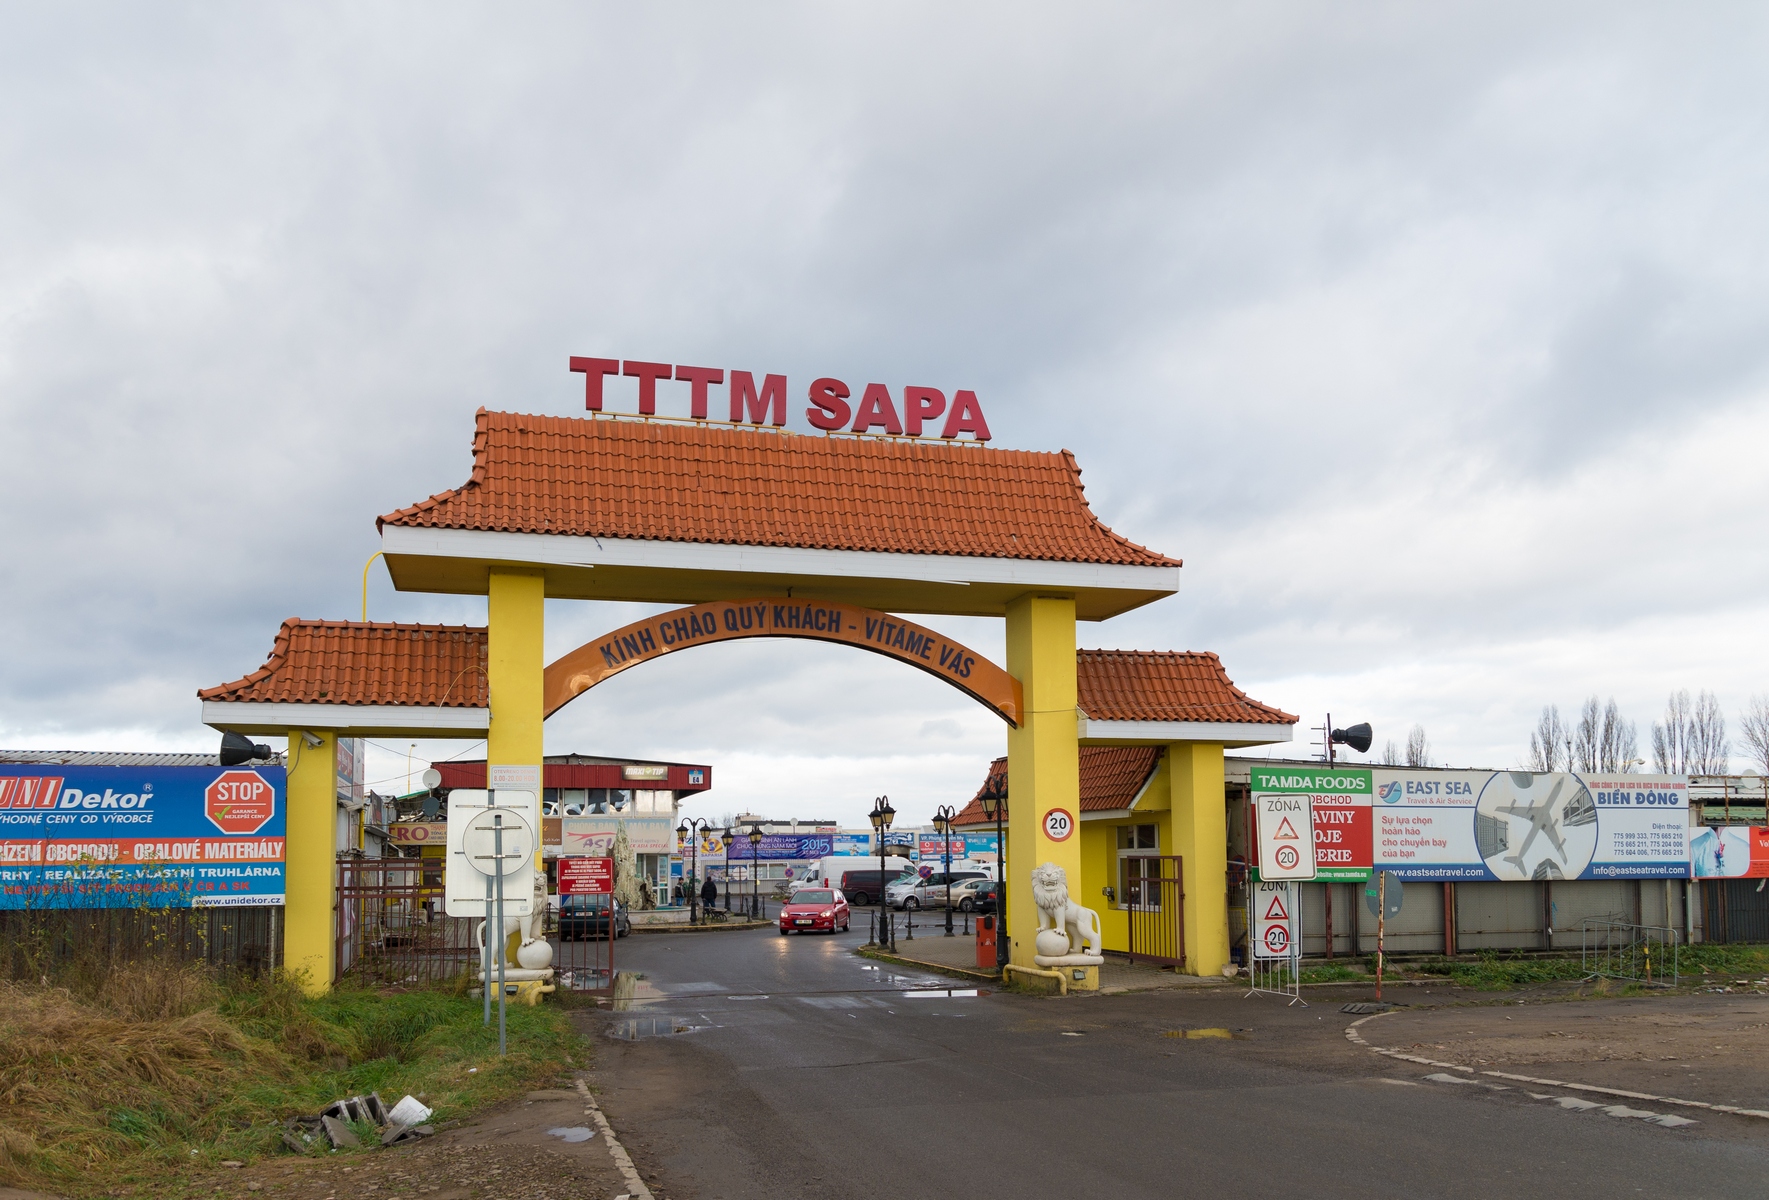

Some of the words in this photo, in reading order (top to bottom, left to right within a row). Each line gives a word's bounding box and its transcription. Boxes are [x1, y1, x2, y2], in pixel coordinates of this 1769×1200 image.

[569, 356, 787, 426] TTTM
[806, 378, 992, 441] SAPA
[600, 628, 656, 668] KÍNH
[660, 611, 717, 645] CHÀO
[723, 602, 767, 632] QUÝ
[774, 603, 841, 633] KHÁCH
[865, 617, 935, 660] VÍTÁME
[938, 643, 975, 678] VÁS
[625, 767, 645, 776] MAXI
[652, 768, 665, 776] TIP
[1258, 775, 1314, 789] TAMDA
[1315, 776, 1366, 789] FOODS
[1406, 781, 1441, 795] EAST
[1445, 781, 1473, 795] SEA
[217, 781, 264, 801] STOP
[1597, 788, 1631, 805] BIỂN
[1635, 789, 1679, 806] ĐÔNG
[60, 788, 154, 808] Dekor
[1447, 797, 1473, 805] Service
[1267, 798, 1301, 812] ZÓNA
[46, 814, 77, 824] CENY
[80, 814, 98, 824] OD
[103, 812, 153, 823] VÝROBCE
[1050, 817, 1067, 829] 20
[1411, 815, 1433, 826] chọn
[134, 838, 201, 861] OBALOVÉ
[204, 838, 283, 859] MATERIÁLY
[801, 838, 830, 854] 2015
[1382, 838, 1398, 846] cho
[1432, 838, 1447, 848] bay
[1280, 851, 1294, 864] 20
[1400, 848, 1416, 859] bạn
[135, 866, 195, 879] VLASTNÍ
[198, 865, 281, 878] TRUHLÁRNA
[1386, 867, 1484, 877] ww.eastseatravel.com
[1592, 865, 1685, 877] info@eastseatravel.com
[196, 880, 215, 891] ČR
[218, 882, 228, 890] A
[232, 881, 250, 890] SK
[195, 896, 281, 906] www.unidekor.cz
[1270, 931, 1285, 946] 20
